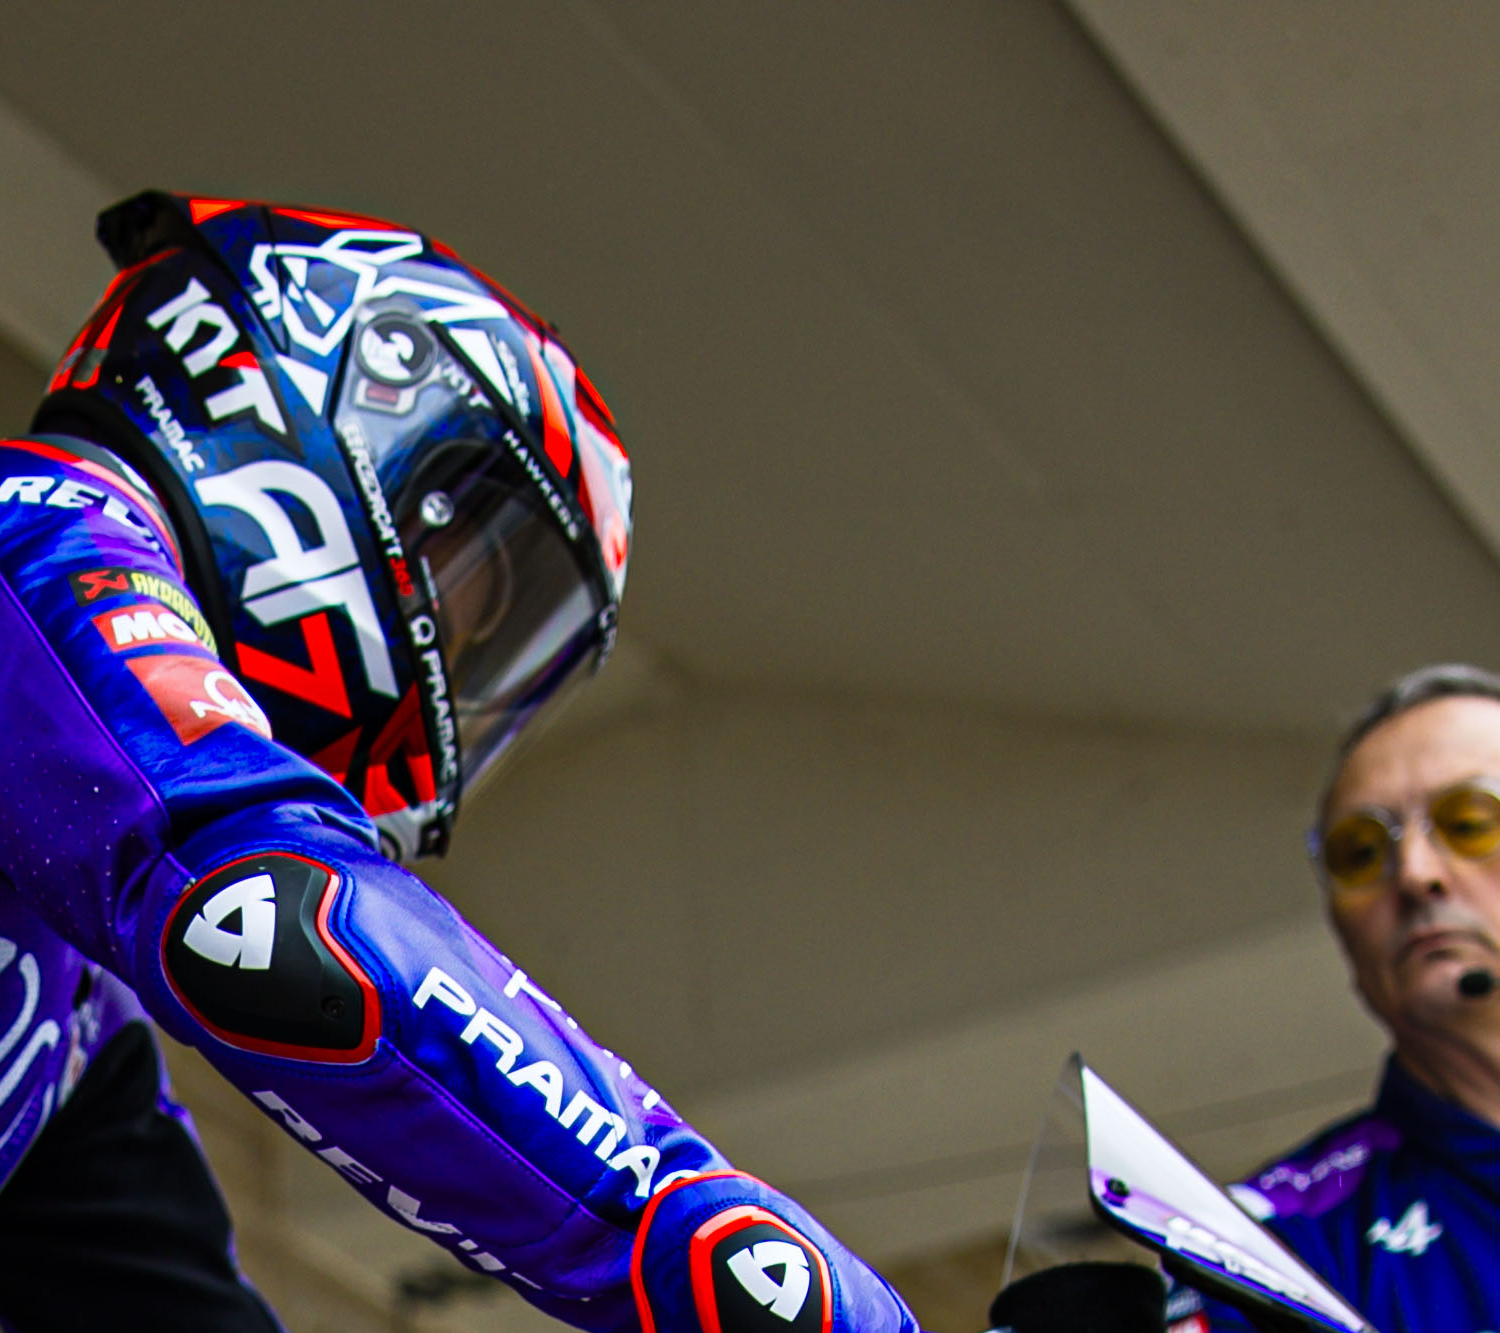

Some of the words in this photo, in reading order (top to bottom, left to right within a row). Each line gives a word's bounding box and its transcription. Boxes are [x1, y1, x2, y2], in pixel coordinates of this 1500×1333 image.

[146, 277, 286, 435] KYT
[135, 375, 204, 473] PRAMAC
[503, 429, 578, 540] HAWKERS
[422, 649, 458, 783] PRAMAC
